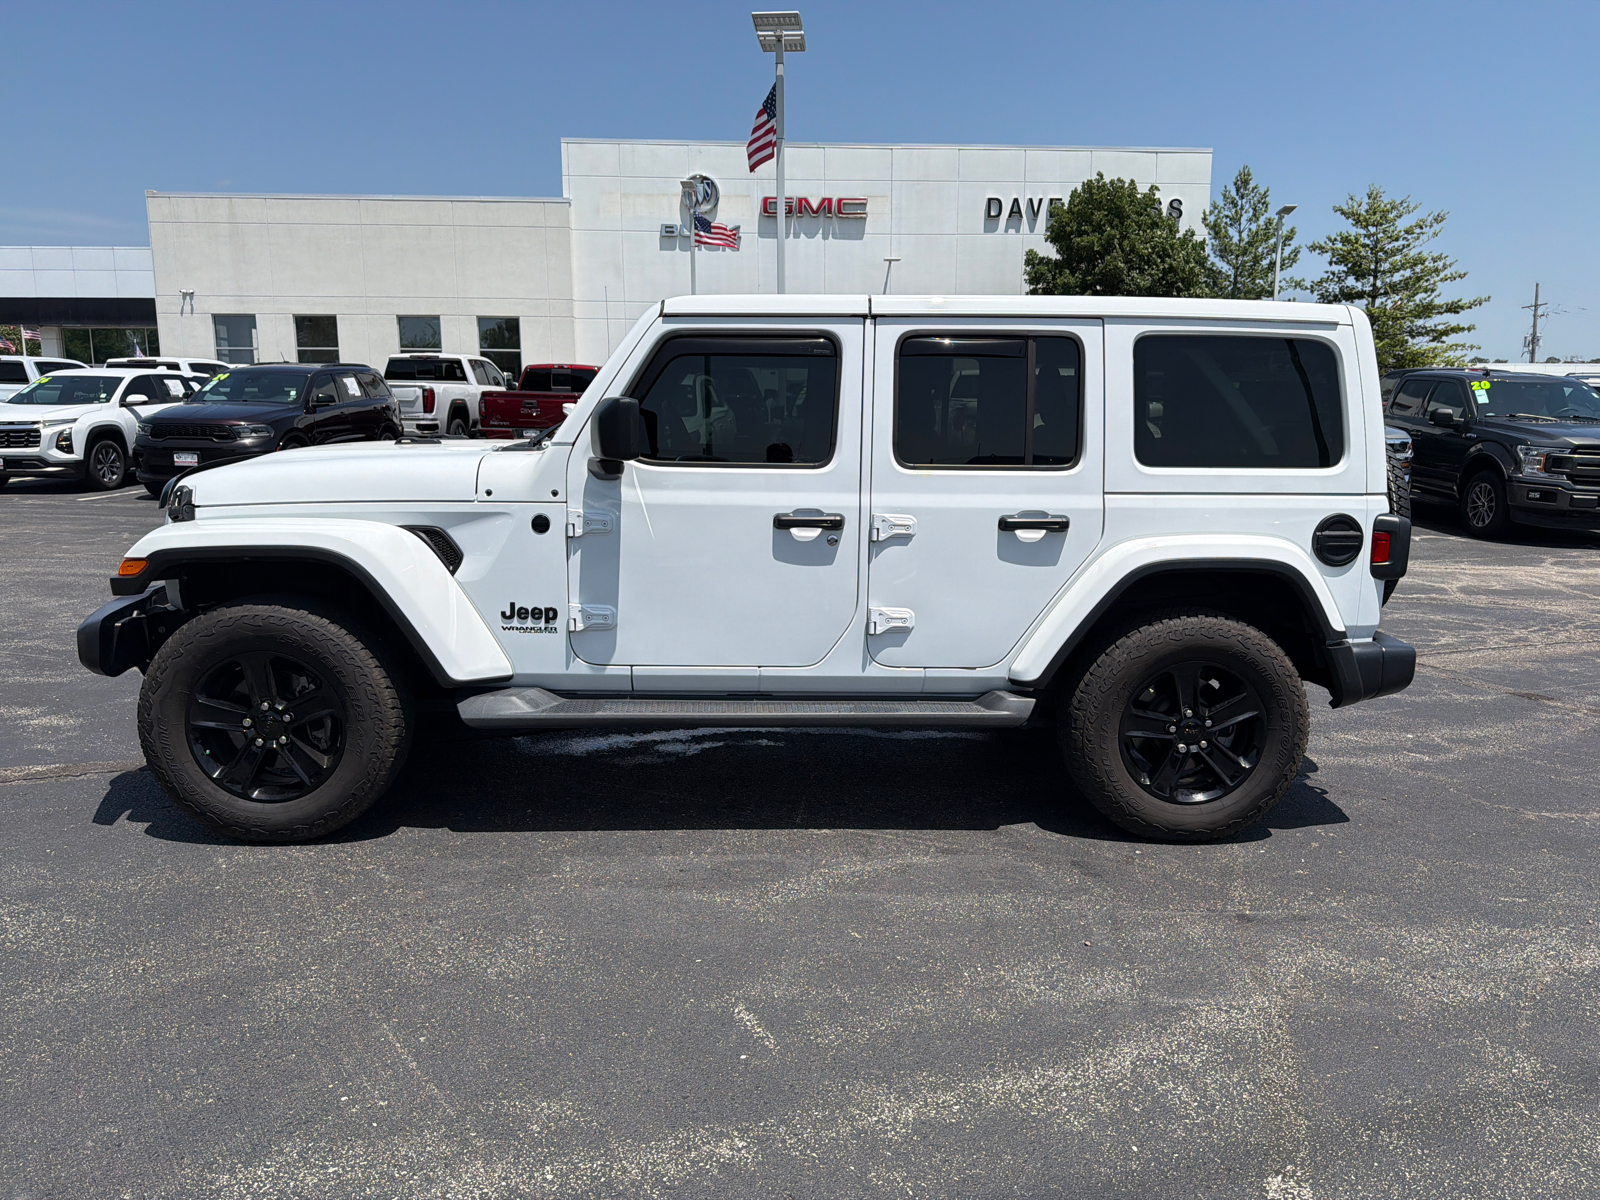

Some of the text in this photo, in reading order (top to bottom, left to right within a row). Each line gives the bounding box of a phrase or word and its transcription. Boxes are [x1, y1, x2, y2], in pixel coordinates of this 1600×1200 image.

[762, 196, 868, 218] GMC
[1470, 380, 1491, 391] 20
[500, 601, 558, 625] Jeep
[1228, 647, 1293, 775] BRIDGESTONE
[158, 715, 272, 826] BRIDGESTONE
[1100, 713, 1147, 812] DUELER
